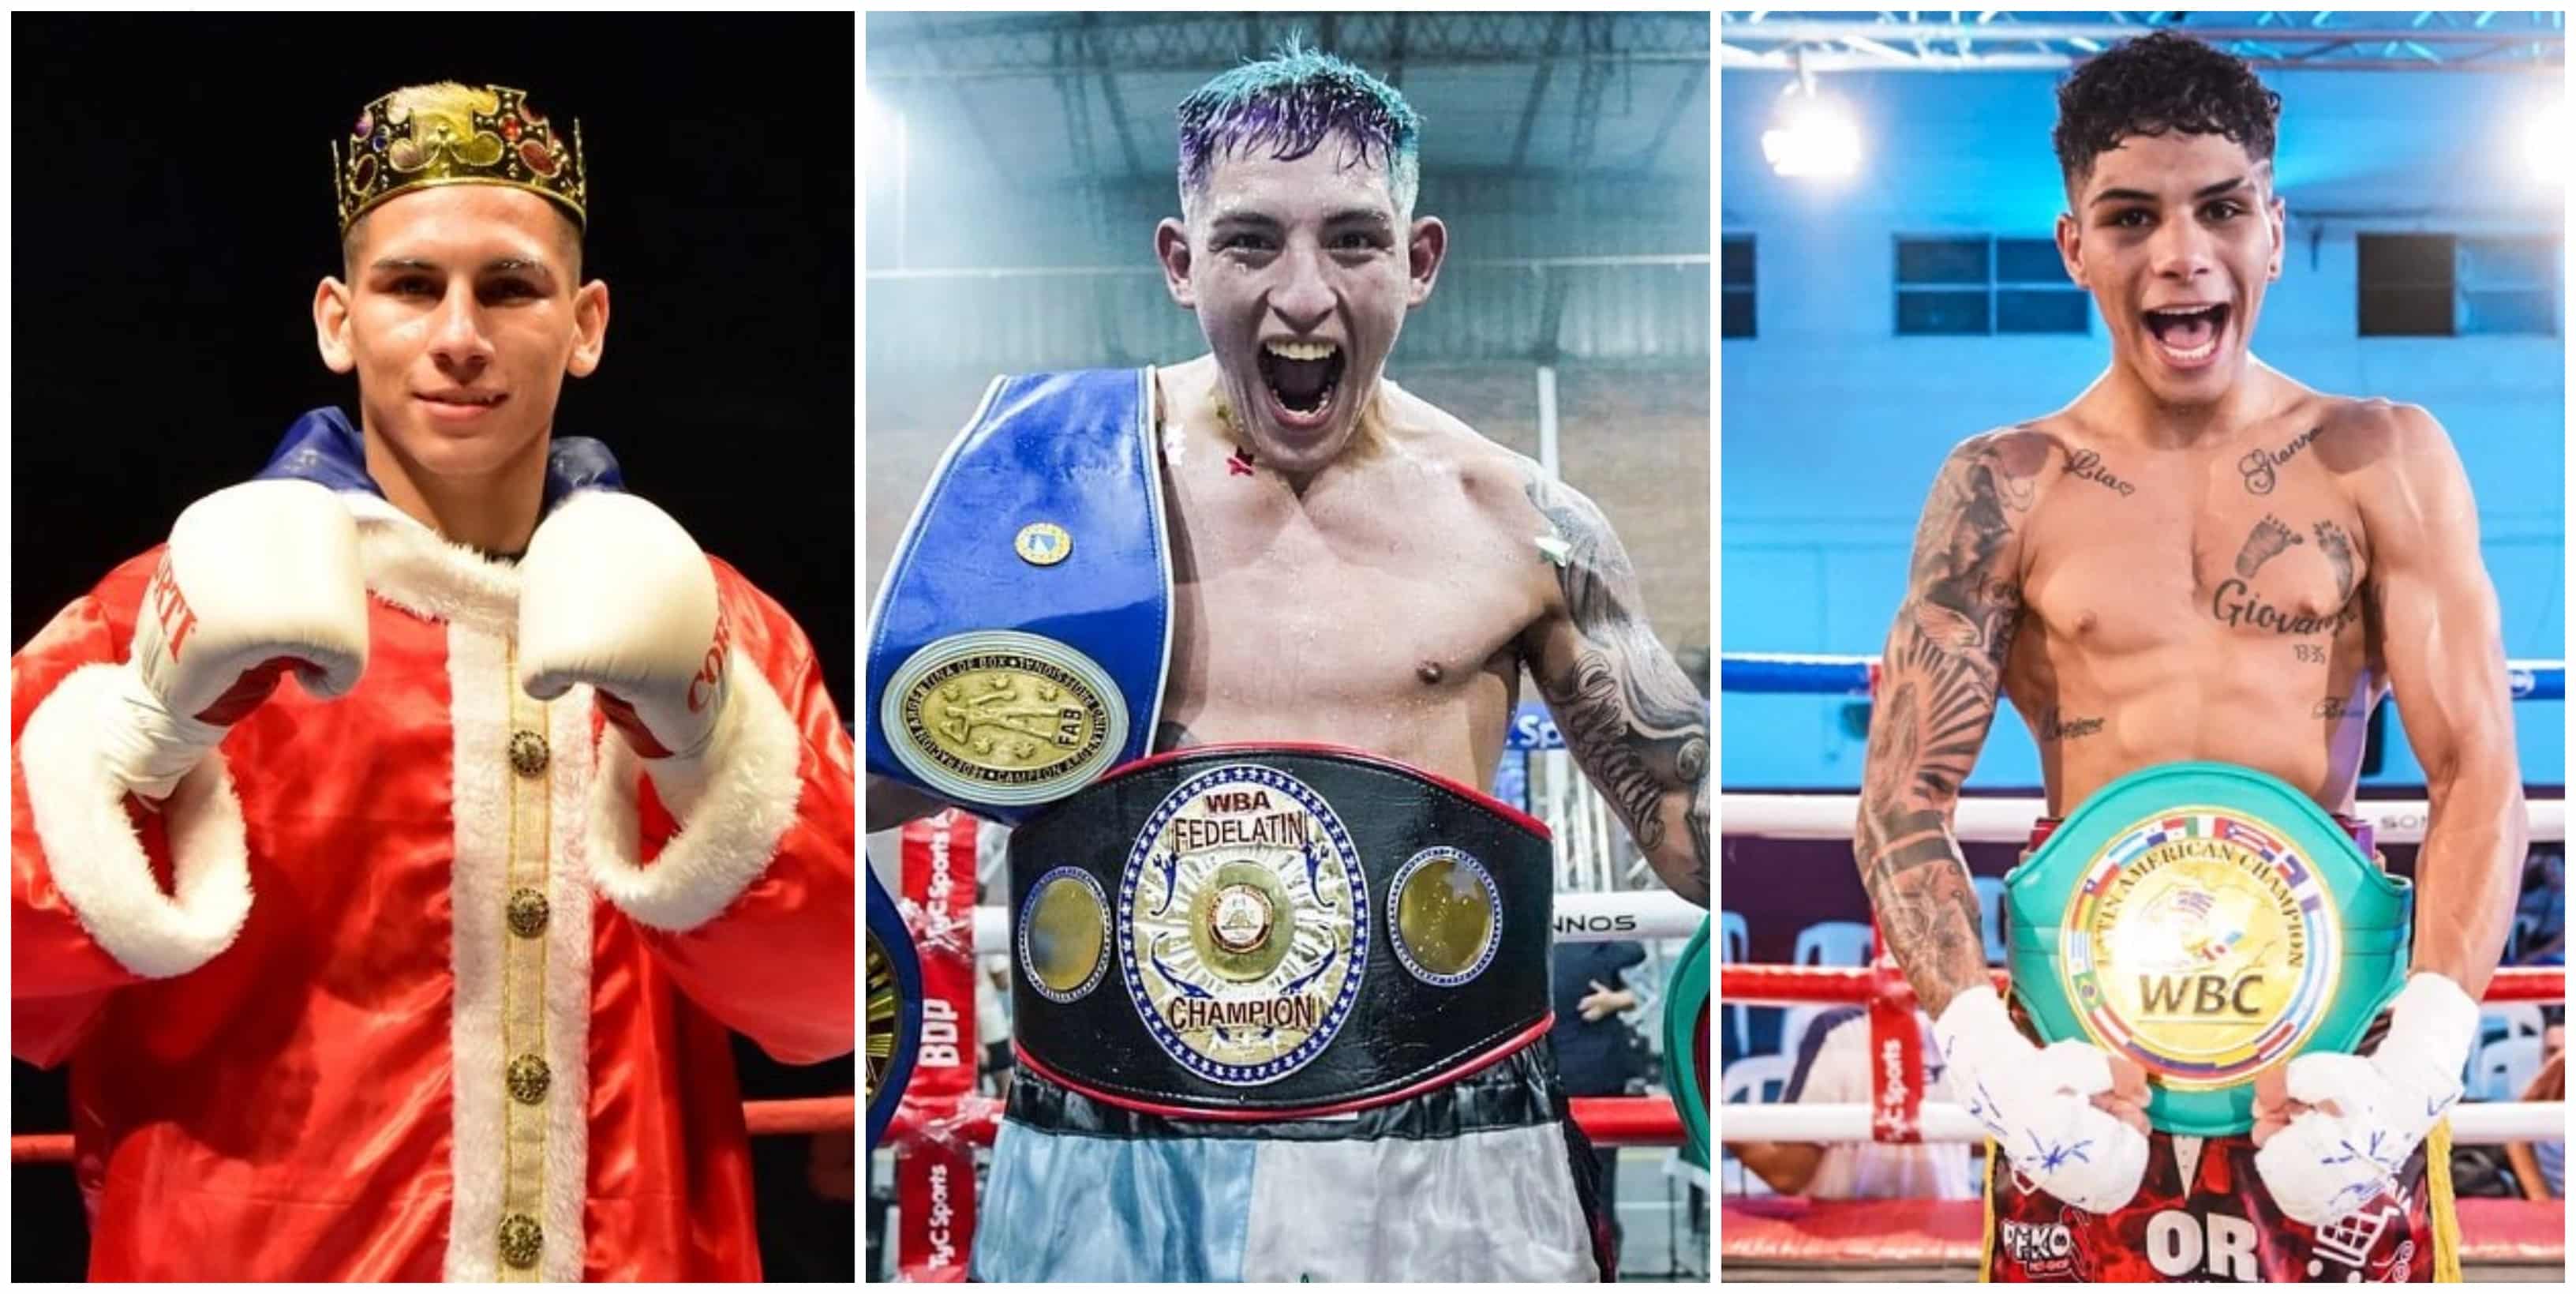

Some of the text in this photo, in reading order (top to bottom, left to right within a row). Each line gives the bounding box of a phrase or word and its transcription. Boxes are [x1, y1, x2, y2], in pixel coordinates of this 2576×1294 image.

[1058, 708, 1082, 745] FAB
[1204, 790, 1271, 816] WBA
[1172, 810, 1309, 853] FEDELATIN
[928, 831, 954, 898] Sports
[1552, 914, 1637, 934] NNOS
[2118, 842, 2233, 887] AMERICAN
[2240, 855, 2305, 968] CHAMPION
[1170, 996, 1318, 1031] CHAMPION
[2139, 973, 2263, 1016] WBC
[918, 999, 960, 1067] BDP
[1881, 1038, 1909, 1106] Sports
[928, 1165, 956, 1270] TyC Sports
